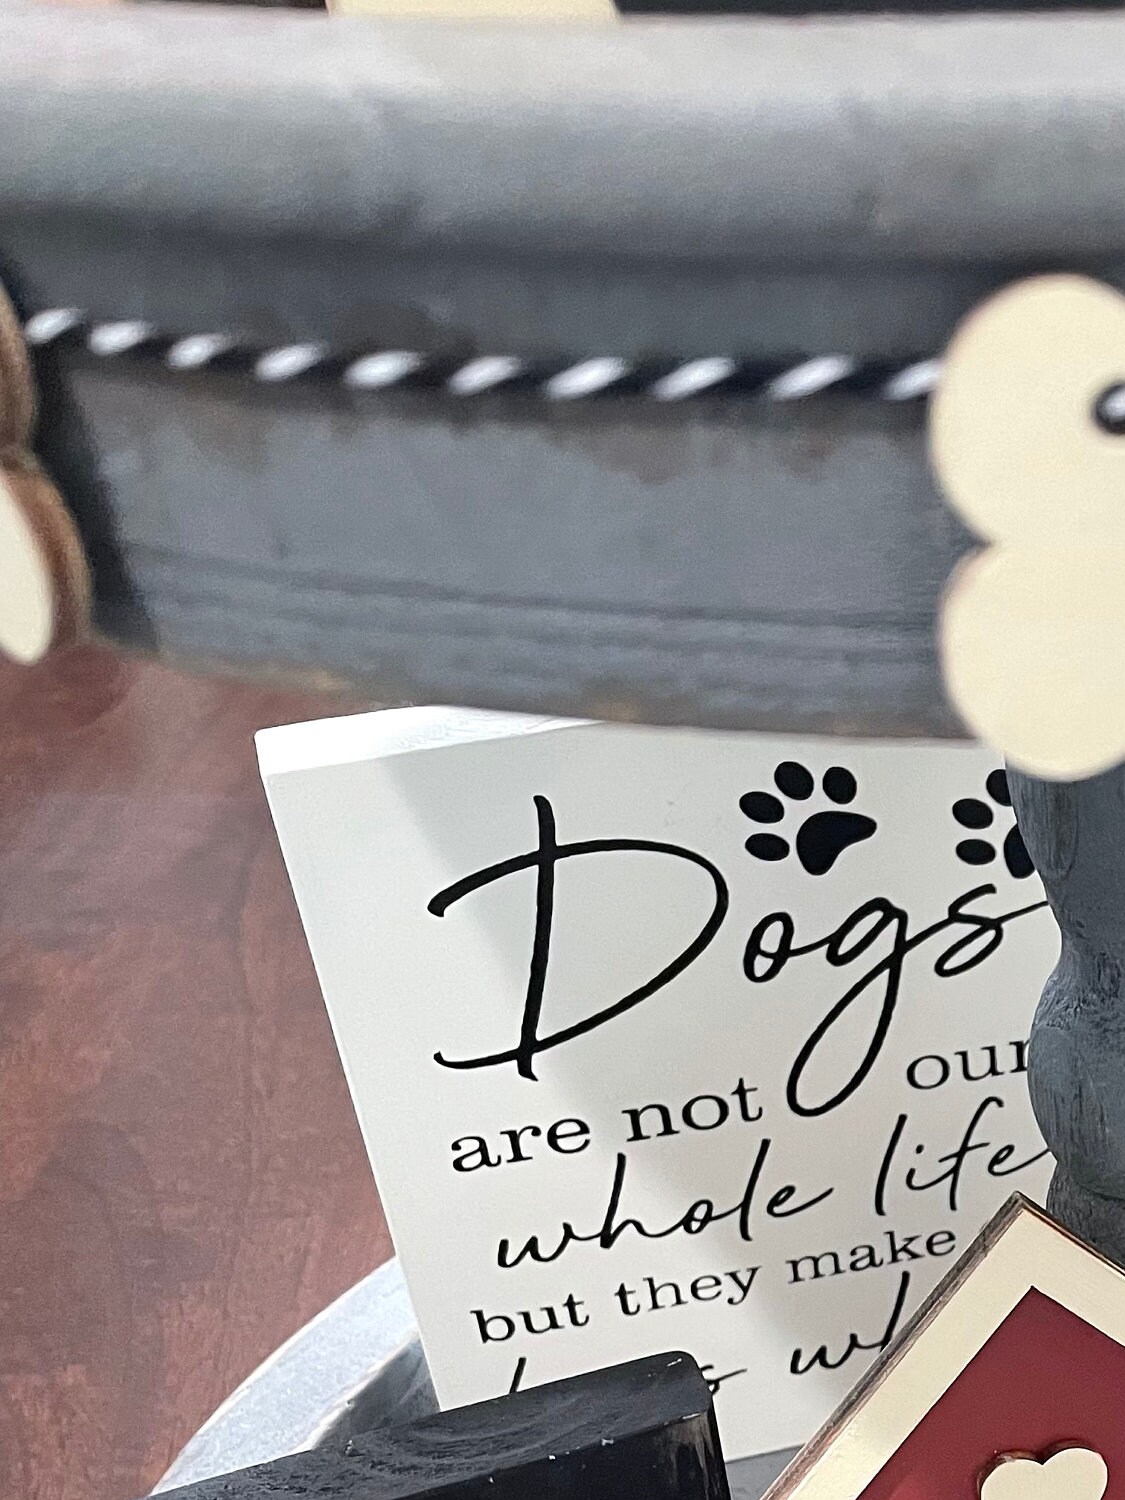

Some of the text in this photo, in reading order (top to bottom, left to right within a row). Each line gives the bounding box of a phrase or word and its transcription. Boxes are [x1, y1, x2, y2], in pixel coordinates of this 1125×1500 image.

[427, 795, 1048, 1117] Dogs
[451, 1038, 1029, 1173] are not our
[497, 1096, 1050, 1269] whole life
[470, 1293, 590, 1344] but
[614, 1266, 762, 1316] they
[785, 1230, 957, 1284] make
